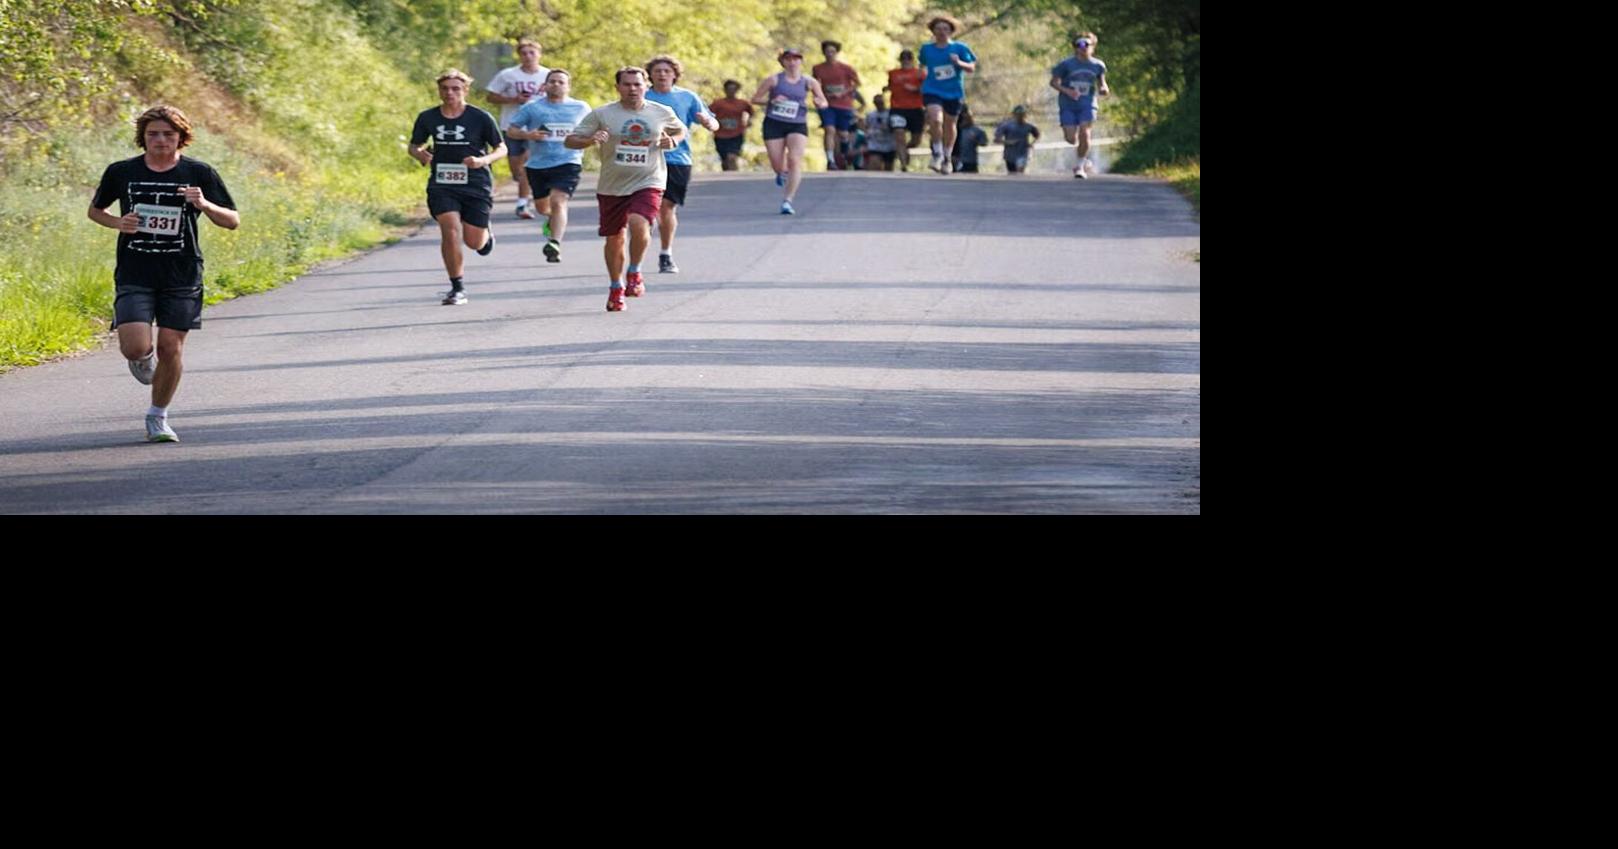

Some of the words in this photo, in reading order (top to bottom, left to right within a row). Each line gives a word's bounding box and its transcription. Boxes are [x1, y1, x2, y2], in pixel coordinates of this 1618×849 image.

[625, 153, 646, 163] 344
[445, 171, 466, 181] 382
[148, 216, 177, 230] 331
